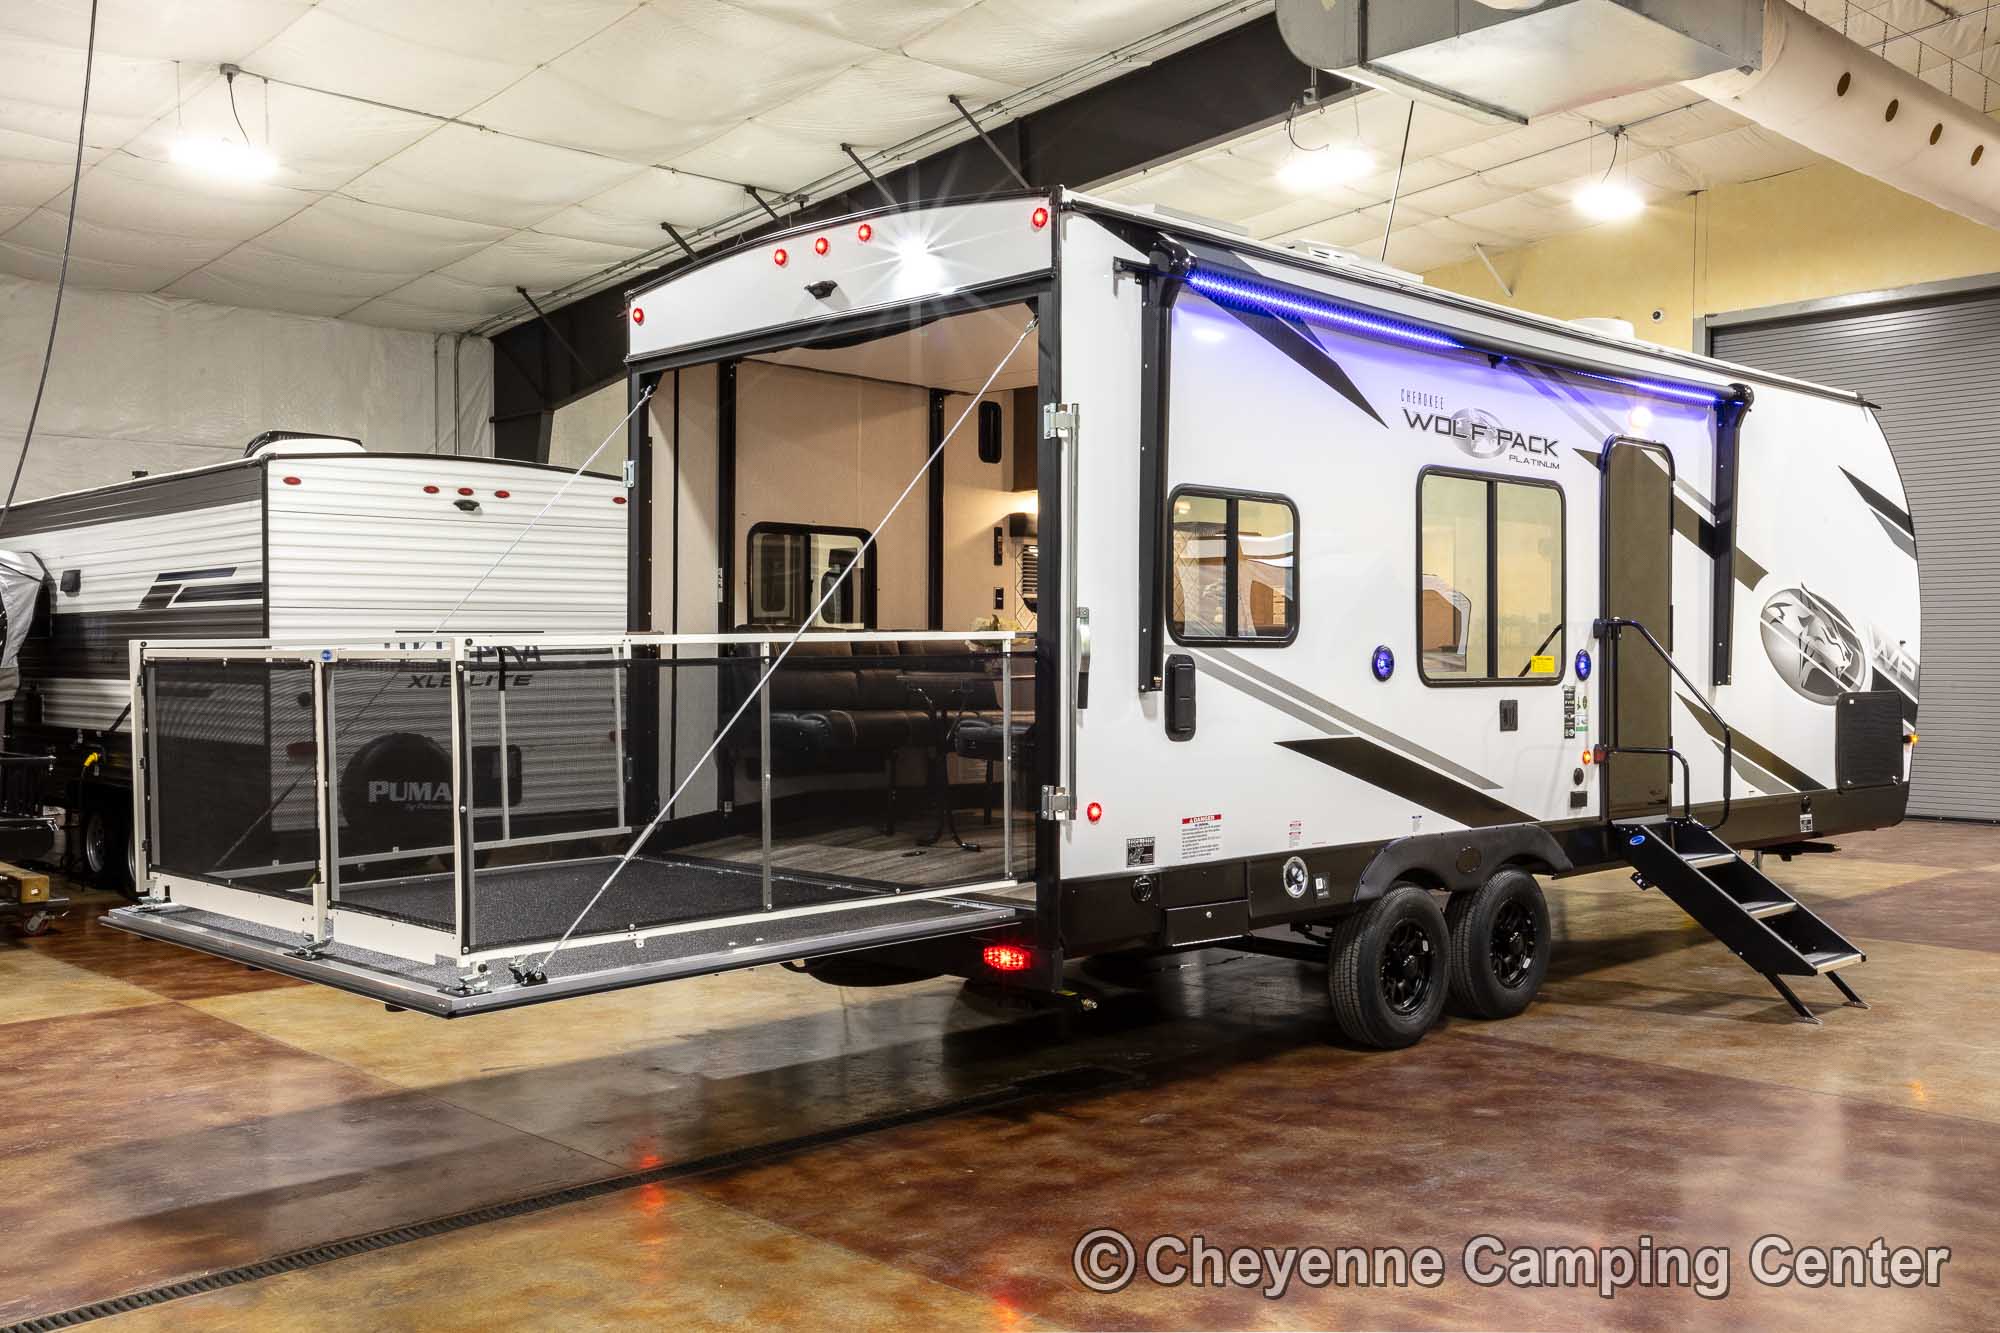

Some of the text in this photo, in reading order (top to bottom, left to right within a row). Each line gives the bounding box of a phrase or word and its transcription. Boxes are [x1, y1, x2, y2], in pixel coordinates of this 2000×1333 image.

[1401, 388, 1444, 410] CHEROKEE
[1403, 408, 1560, 458] WOLF PACK
[1508, 453, 1561, 470] PLATINUM
[368, 780, 453, 802] PUMA
